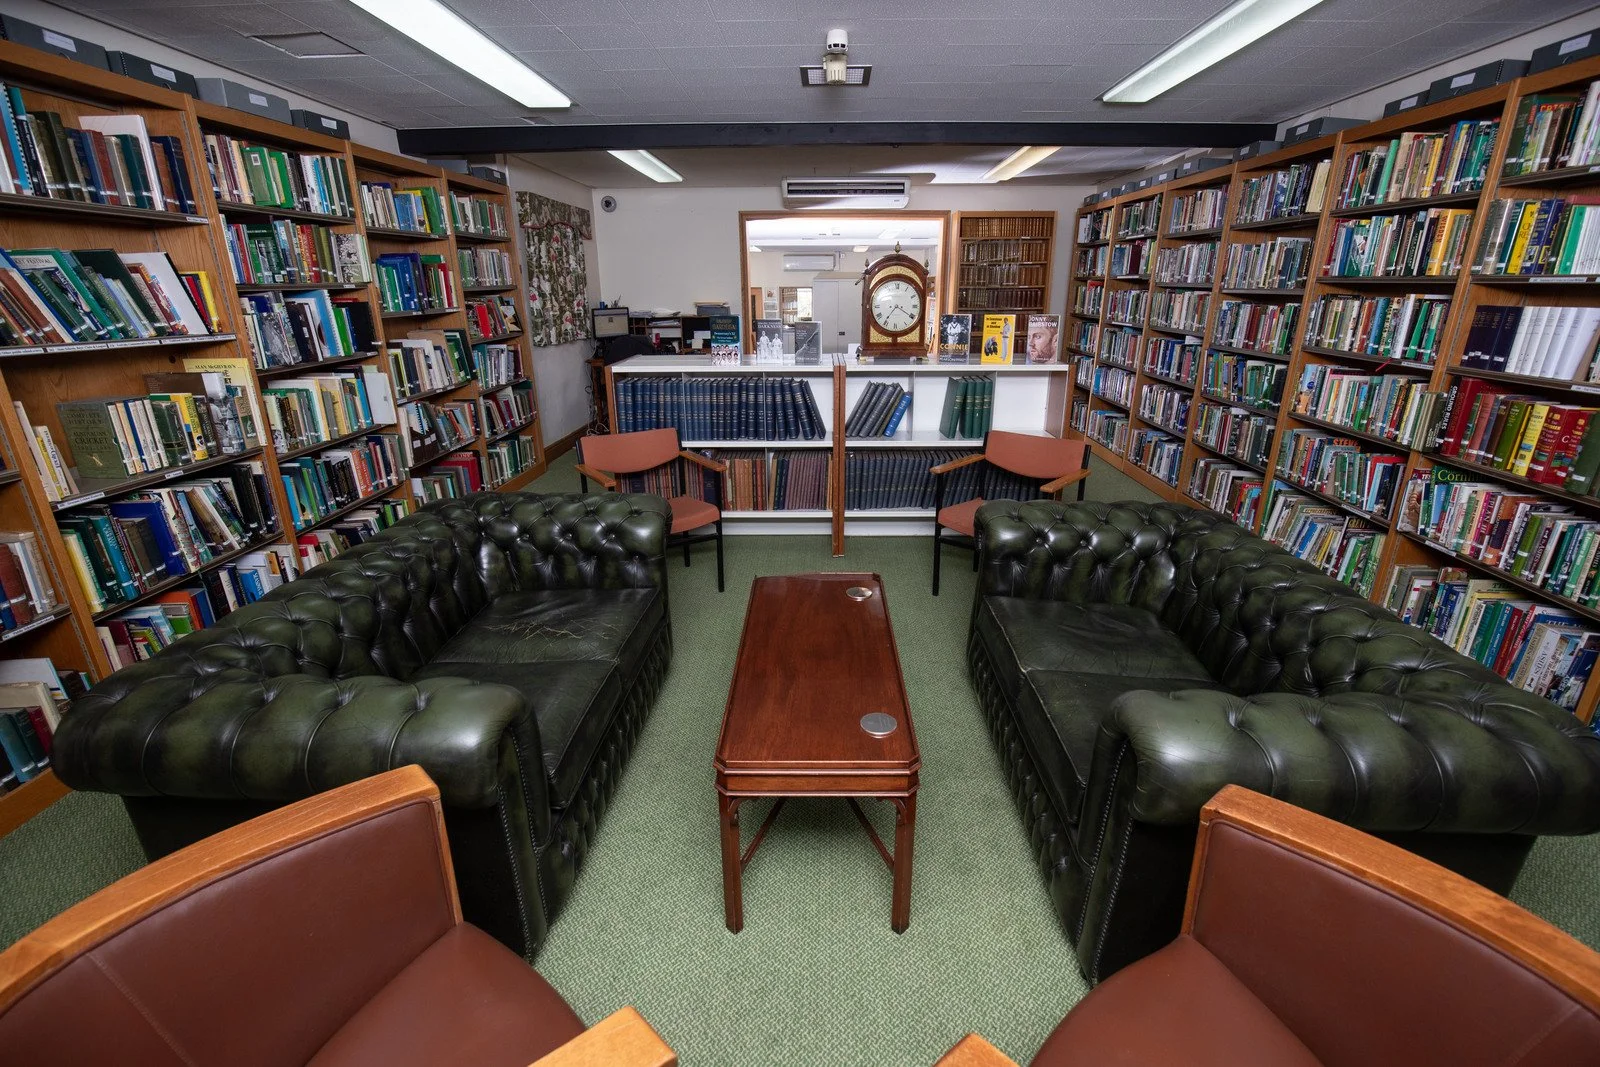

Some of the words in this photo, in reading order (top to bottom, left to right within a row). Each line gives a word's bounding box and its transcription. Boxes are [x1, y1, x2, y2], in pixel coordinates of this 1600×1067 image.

[1435, 214, 1447, 244] WISDEN
[1445, 385, 1457, 411] GROUND
[1440, 411, 1450, 429] RULES
[1533, 649, 1548, 675] ASHES
